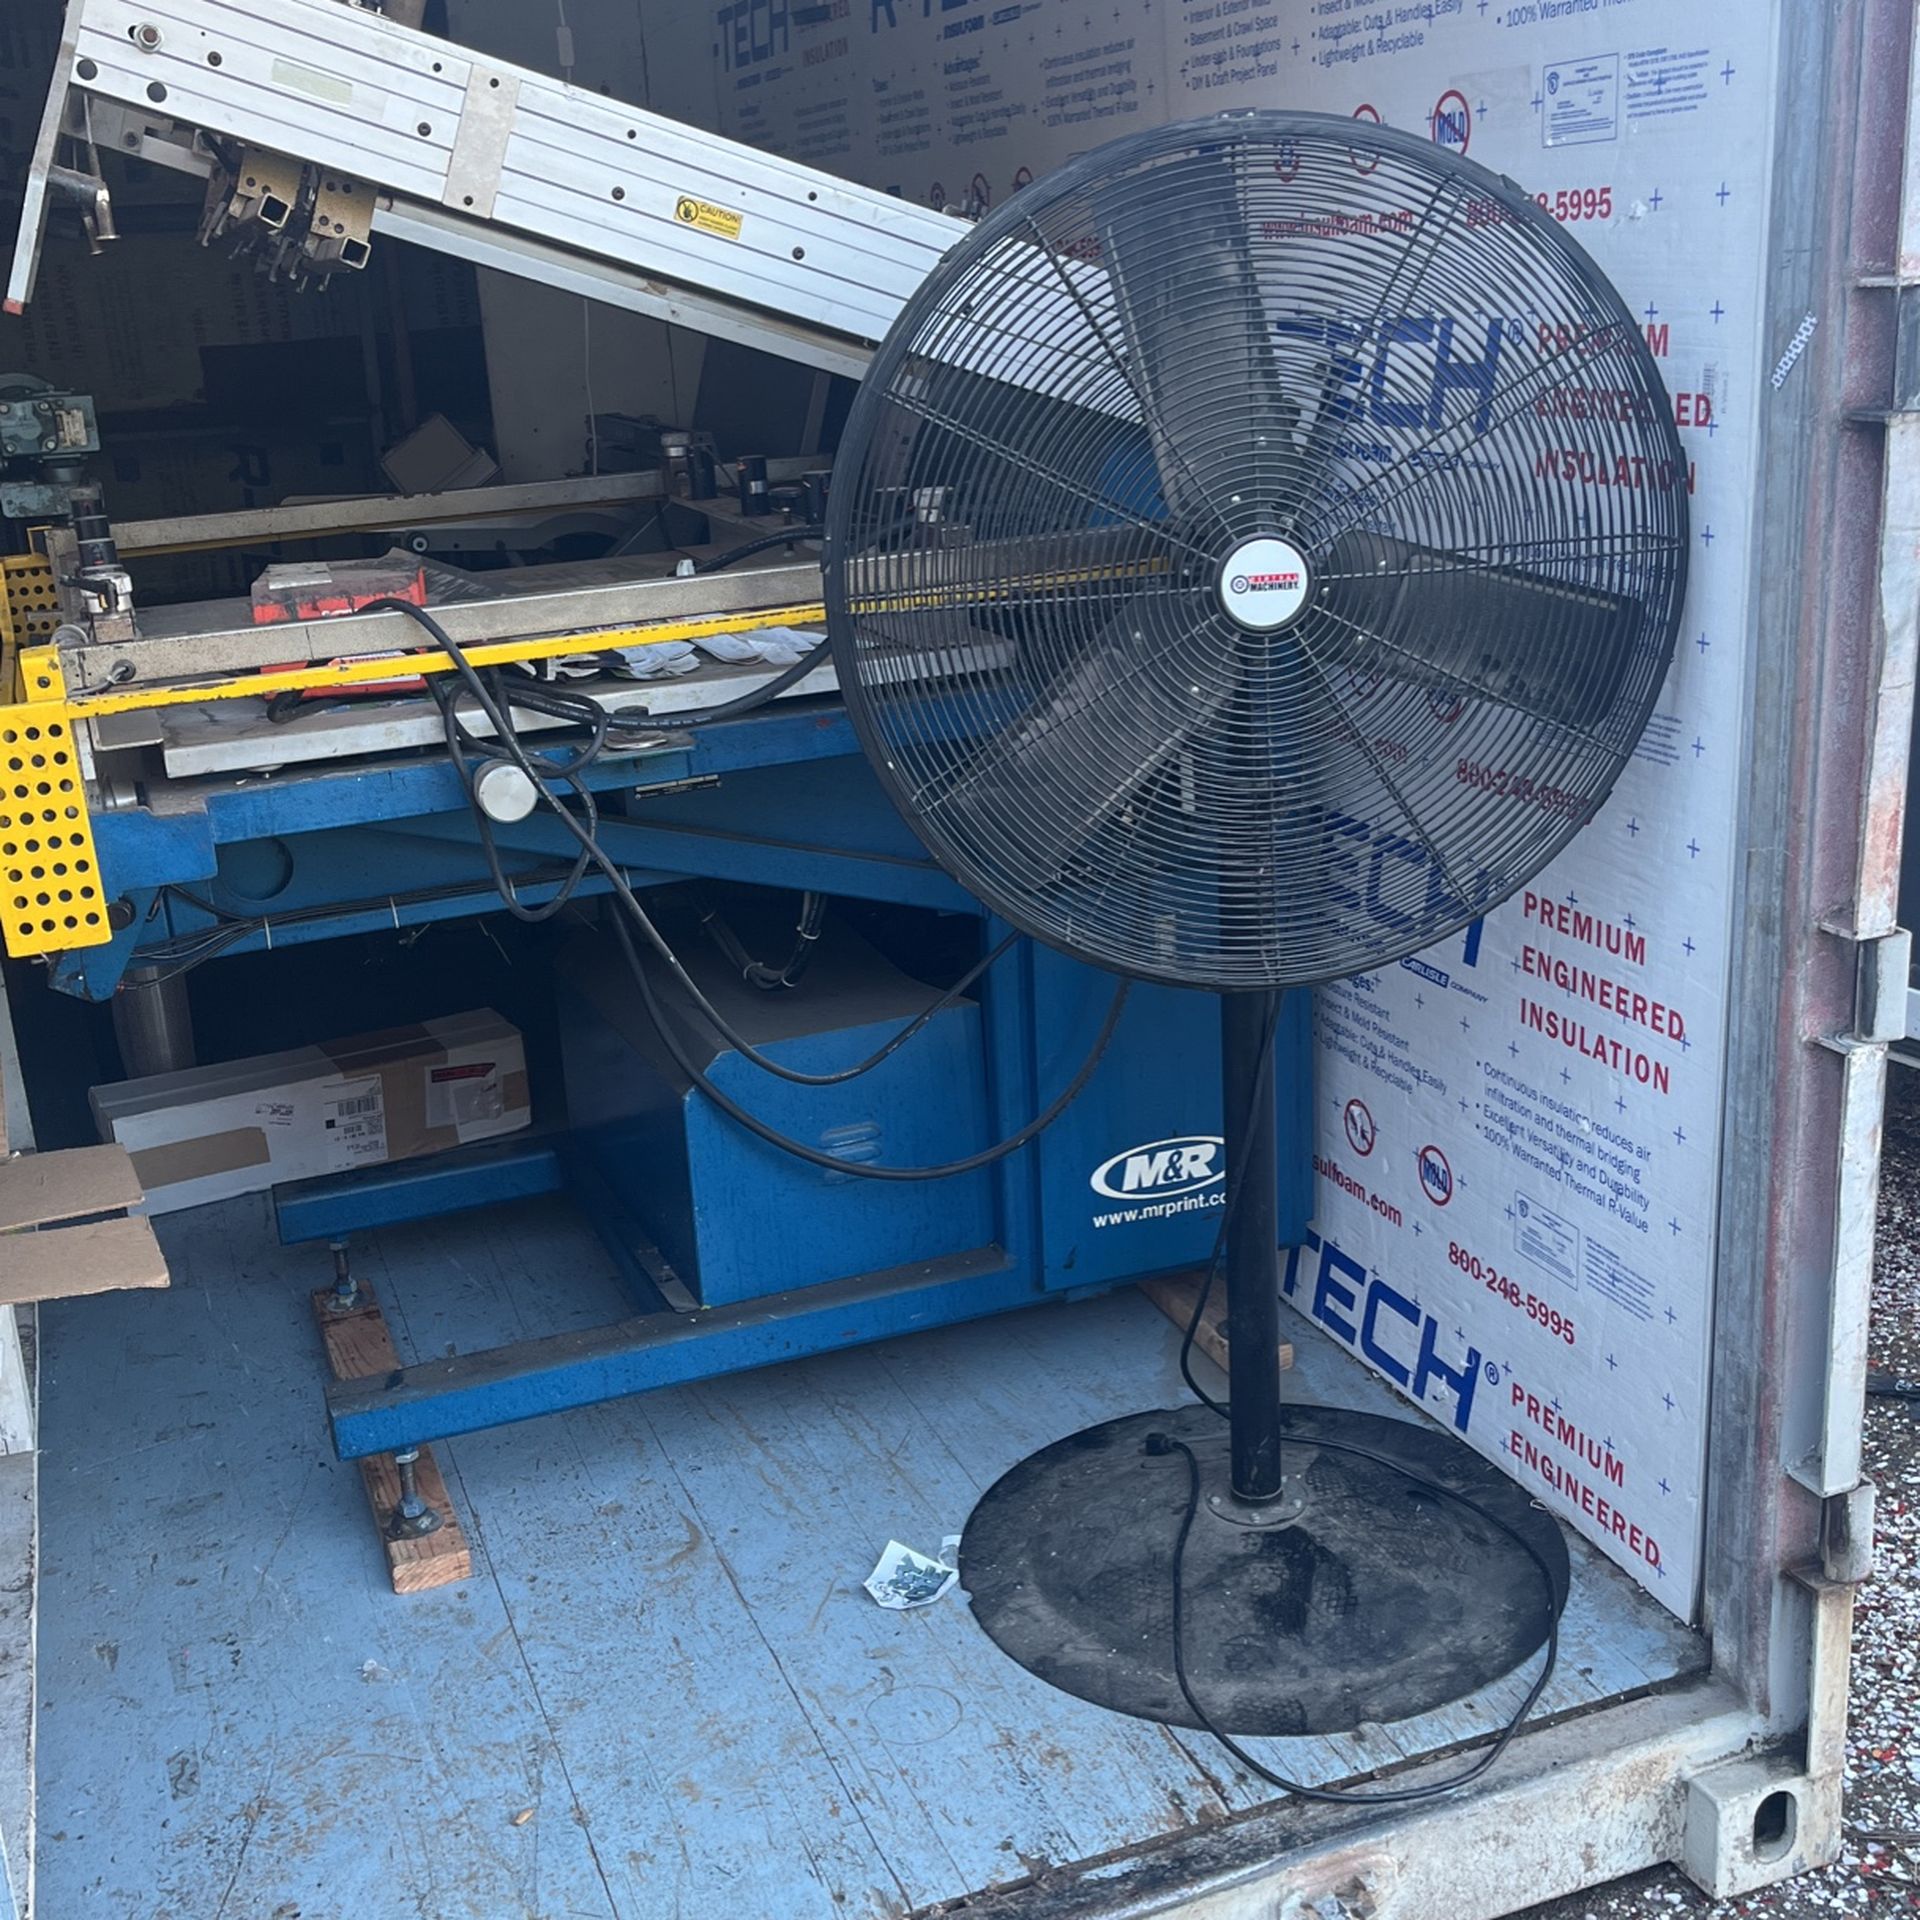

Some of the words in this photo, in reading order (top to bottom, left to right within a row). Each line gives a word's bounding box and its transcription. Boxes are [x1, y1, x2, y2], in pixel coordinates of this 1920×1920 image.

[1367, 40, 1375, 56] &
[1385, 10, 1393, 26] &
[1506, 6, 1537, 27] 100%
[1437, 111, 1465, 144] MOLD
[1524, 891, 1645, 966] PREMIUM
[1402, 957, 1447, 986] CARLISLE
[1522, 945, 1684, 1041] ENGINEERED
[1344, 1006, 1350, 1020] &
[1351, 1011, 1371, 1031] Mold
[1372, 1021, 1410, 1054] Resistant
[1520, 998, 1668, 1094] INSULATION
[1363, 1056, 1370, 1070] &
[1371, 1059, 1413, 1095] Recyclable
[1379, 1045, 1387, 1060] &
[1388, 1050, 1421, 1082] Handles
[1422, 1070, 1448, 1097] Easily
[1484, 1062, 1538, 1101] Continuous
[1591, 1121, 1634, 1153] reduces
[1636, 1146, 1652, 1162] air
[1484, 1083, 1533, 1120] infiltration
[1534, 1113, 1554, 1132] and
[1556, 1123, 1595, 1156] thermal
[1598, 1145, 1641, 1185] bridging
[1122, 1143, 1216, 1191] M&R
[1312, 1154, 1403, 1229] sulfoam.com
[1423, 1156, 1448, 1194] MOLD
[1483, 1104, 1525, 1139] Excellent
[1527, 1128, 1574, 1168] Versatility
[1576, 1159, 1596, 1179] and
[1599, 1169, 1650, 1212] Durability
[1484, 1126, 1510, 1152] 100%
[1511, 1141, 1561, 1182] Warranted
[1564, 1171, 1606, 1208] Thermal
[1609, 1198, 1649, 1234] R-Value
[1448, 1241, 1575, 1345] 800-248-5995
[1512, 1382, 1624, 1488] PREMIUM
[1510, 1429, 1660, 1569] ENGINEERED
